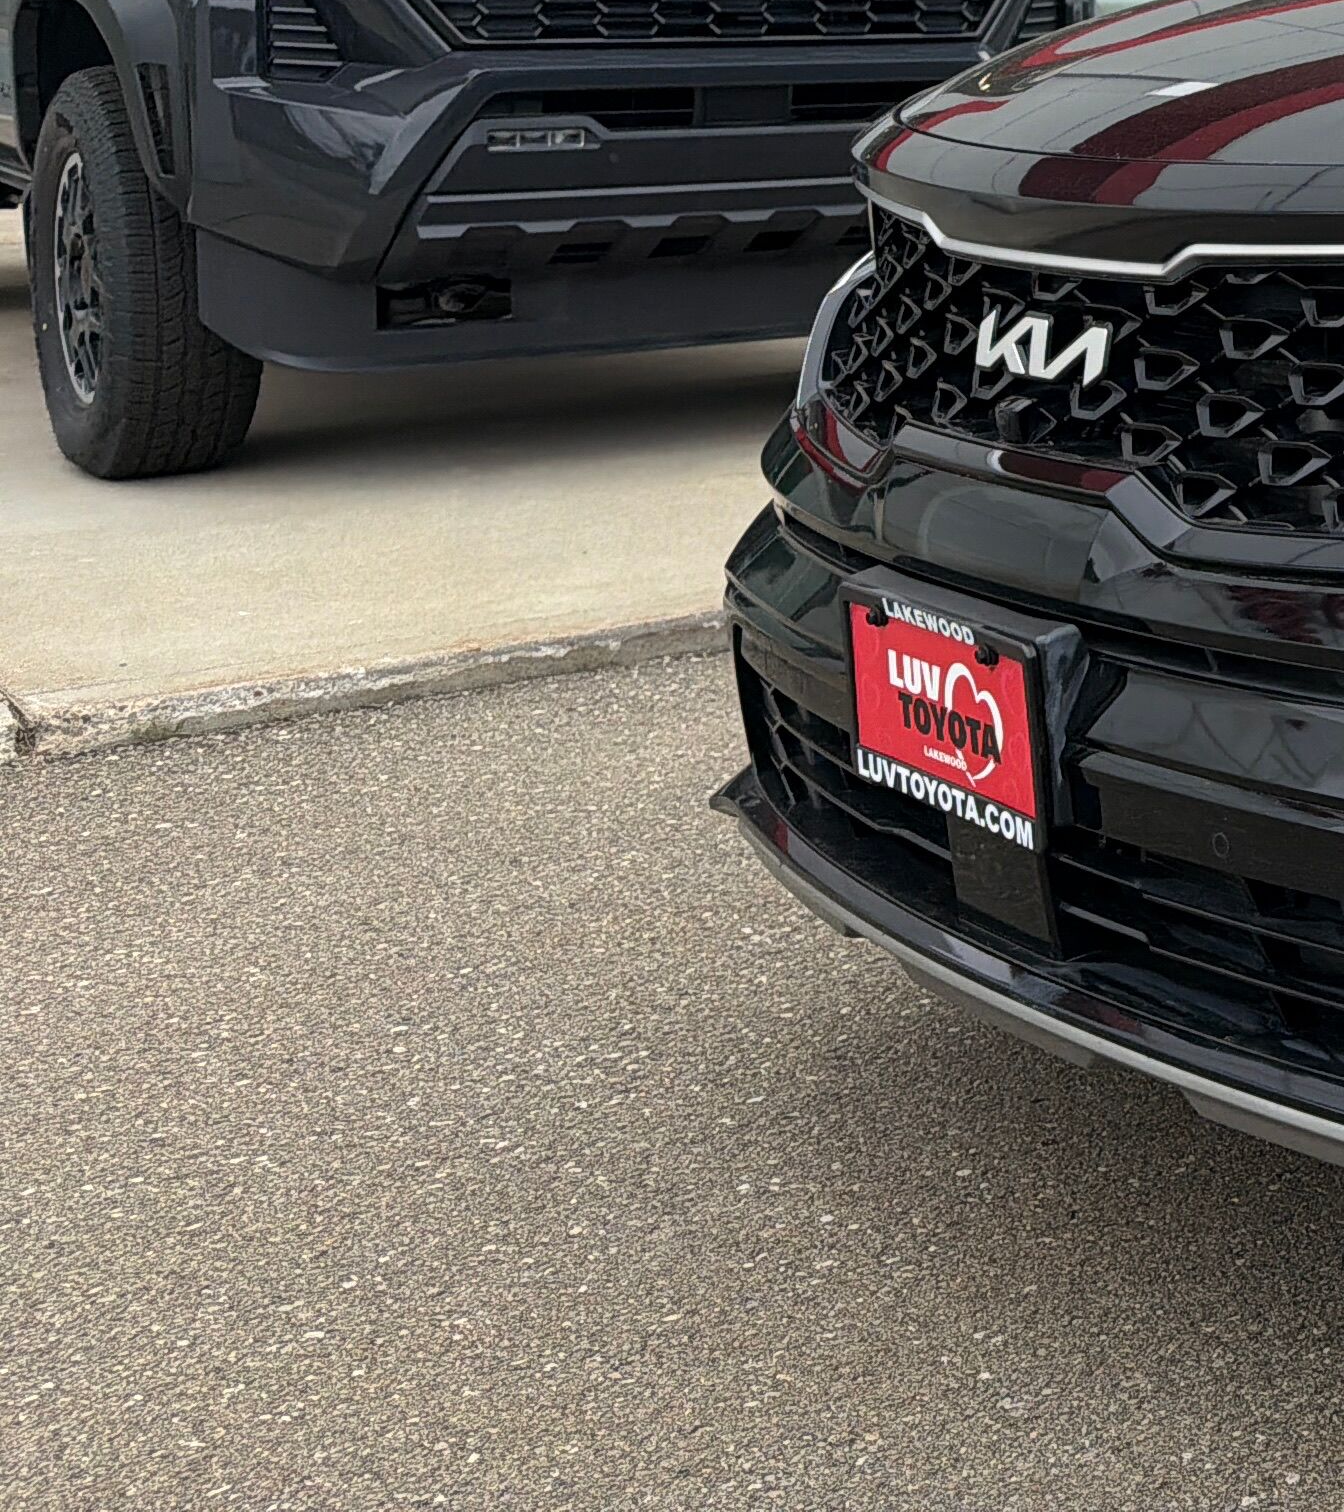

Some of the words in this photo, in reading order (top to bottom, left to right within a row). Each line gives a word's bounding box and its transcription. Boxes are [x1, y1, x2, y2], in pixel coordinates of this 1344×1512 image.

[975, 309, 1108, 388] KIA
[881, 597, 975, 645] LAKEWOOD
[887, 649, 940, 701] LUV
[898, 694, 1001, 763] TOYOTA
[924, 745, 967, 771] LAKEWOOD
[857, 748, 1034, 850] LUVTOYOTA.COM
